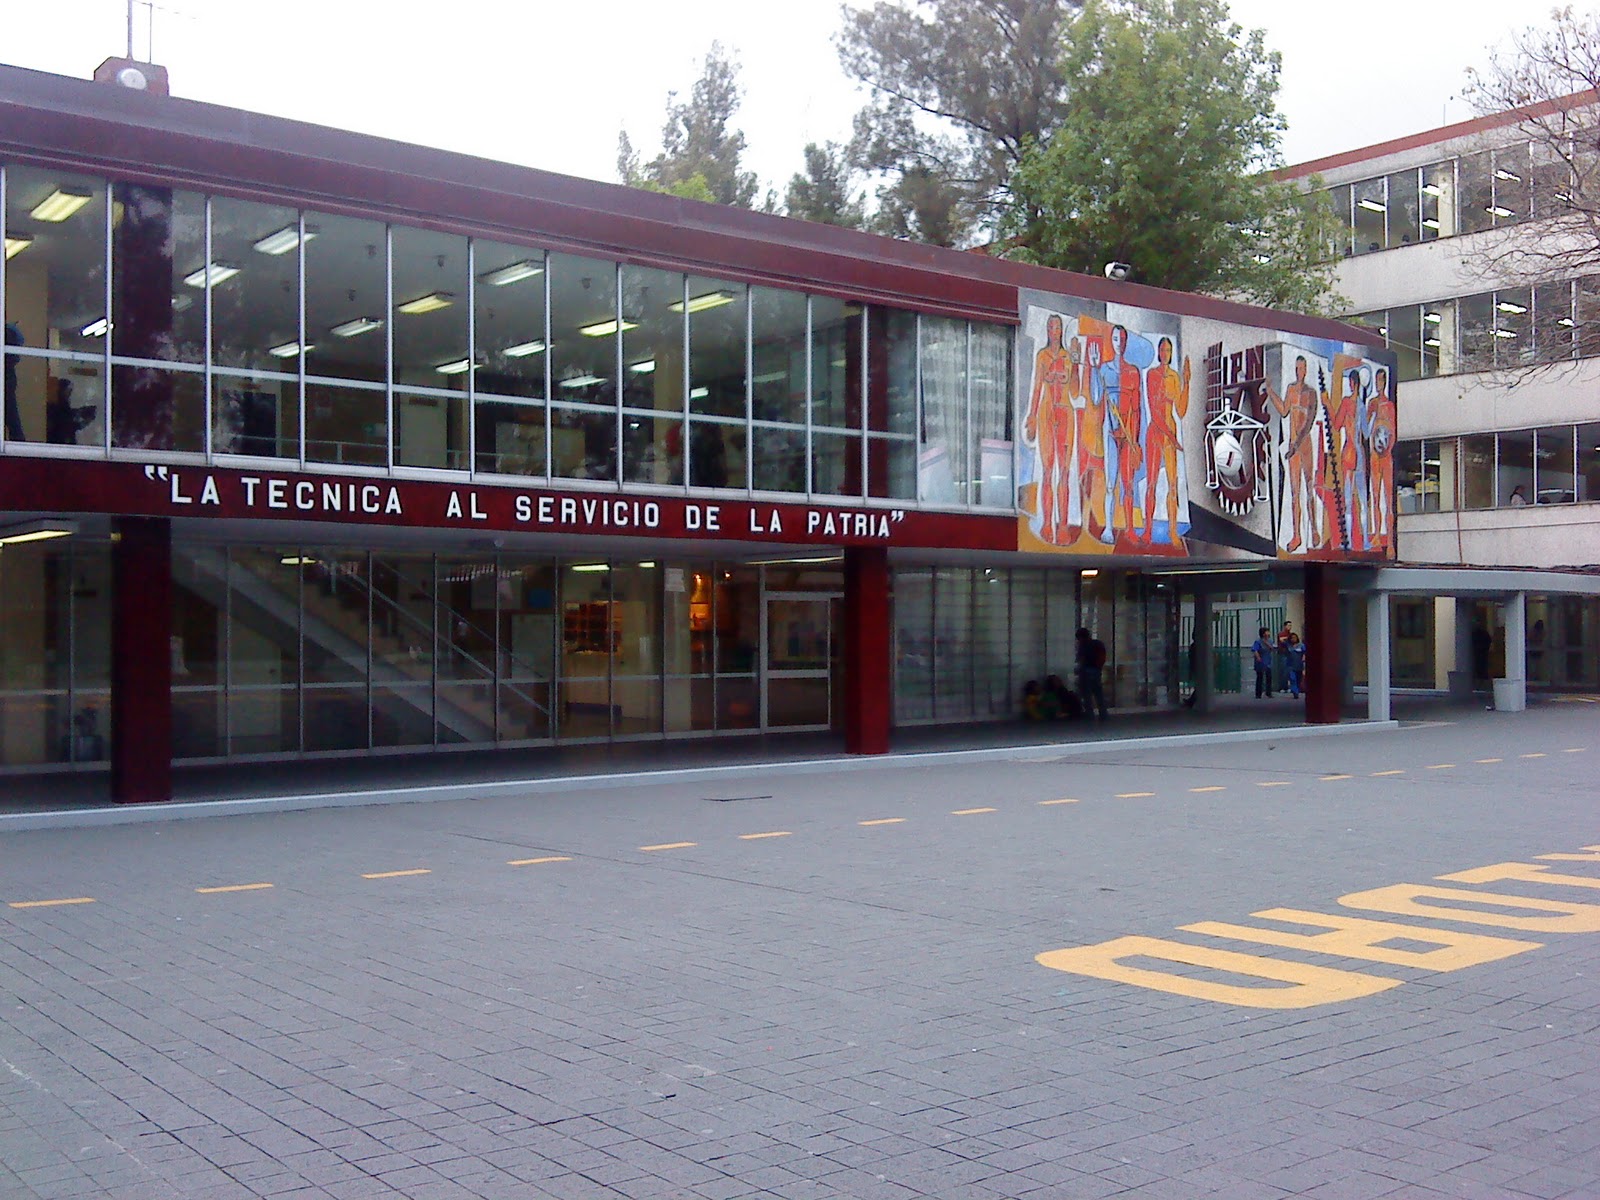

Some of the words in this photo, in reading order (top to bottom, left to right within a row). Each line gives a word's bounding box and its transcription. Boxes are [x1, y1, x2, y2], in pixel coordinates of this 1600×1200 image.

[1222, 345, 1265, 386] IPN
[241, 477, 403, 515] TECNICA
[446, 491, 488, 520] AL
[515, 495, 660, 528] SERVICIO
[685, 505, 721, 531] DE
[750, 508, 782, 533] LA
